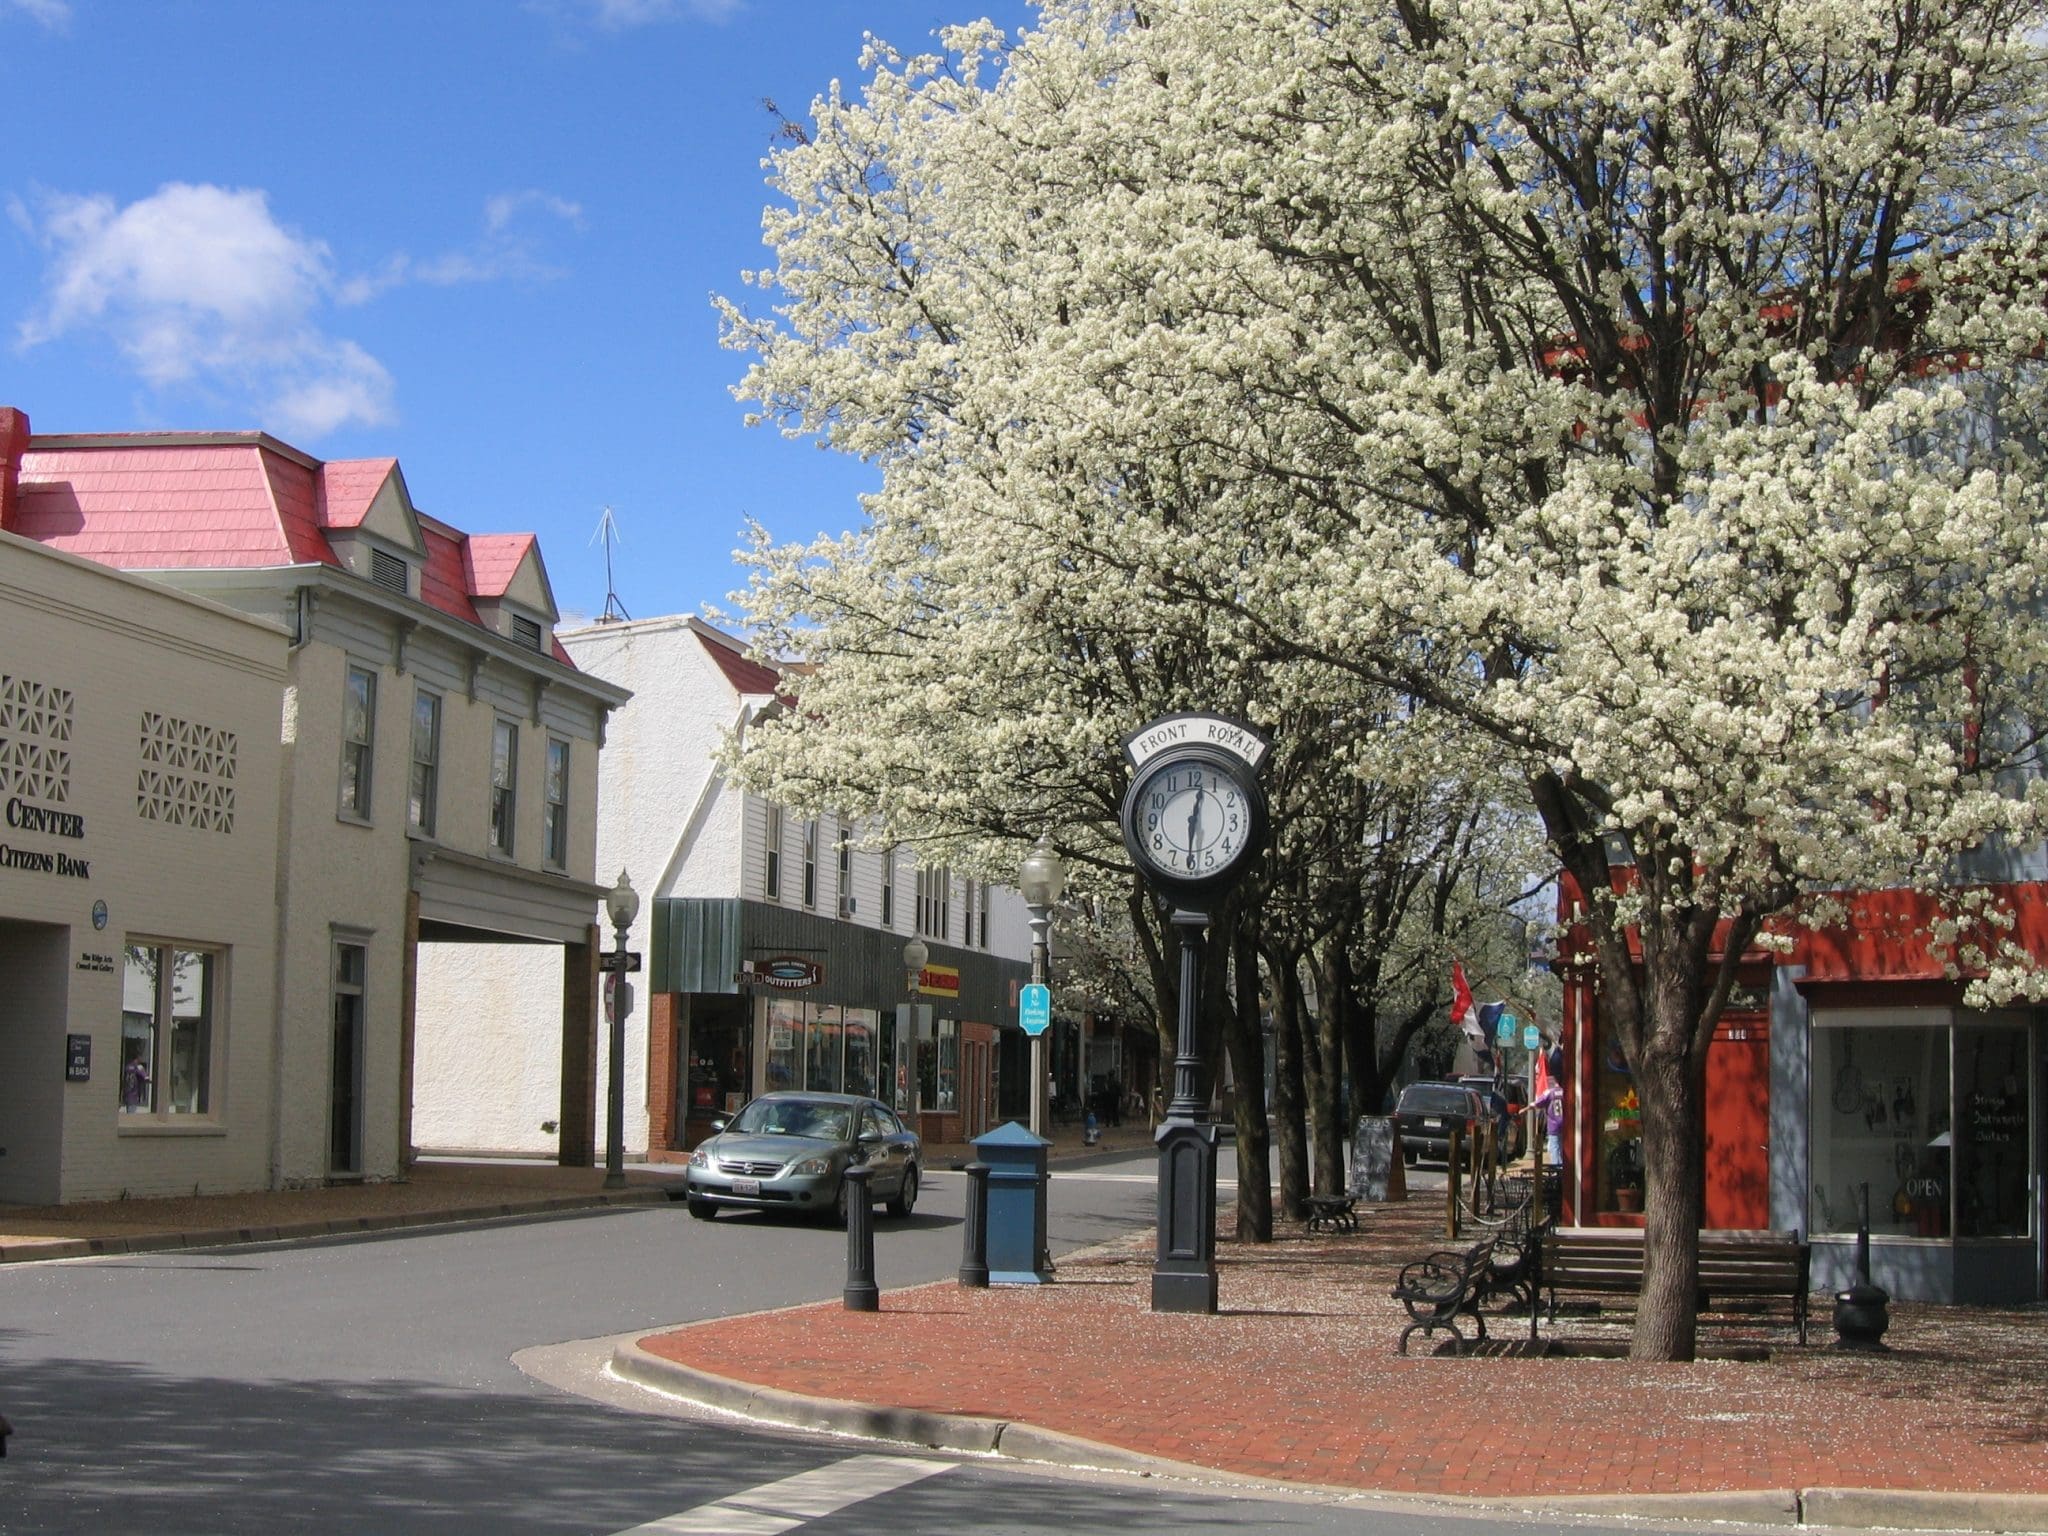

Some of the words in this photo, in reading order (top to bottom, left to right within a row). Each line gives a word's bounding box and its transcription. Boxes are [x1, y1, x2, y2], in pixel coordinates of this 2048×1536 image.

[1139, 723, 1188, 754] FRONT
[1207, 724, 1256, 755] ROYAL
[1167, 776, 1177, 792] 11
[1187, 771, 1202, 788] 12
[1212, 777, 1217, 793] 1
[1151, 792, 1165, 810] 10
[1226, 791, 1235, 808] 2
[6, 797, 85, 839] CENTER
[1148, 813, 1158, 831] 9
[1229, 813, 1238, 832] 3
[1153, 833, 1163, 850] 8
[1221, 836, 1231, 854] 4
[0, 843, 54, 873] CITIZENS
[56, 852, 90, 880] BANK
[1168, 849, 1178, 867] 7
[1204, 849, 1214, 867] 5
[765, 975, 812, 988] OUTFITTERS
[75, 1067, 89, 1076] BACK
[1906, 1178, 1942, 1197] OPEN
